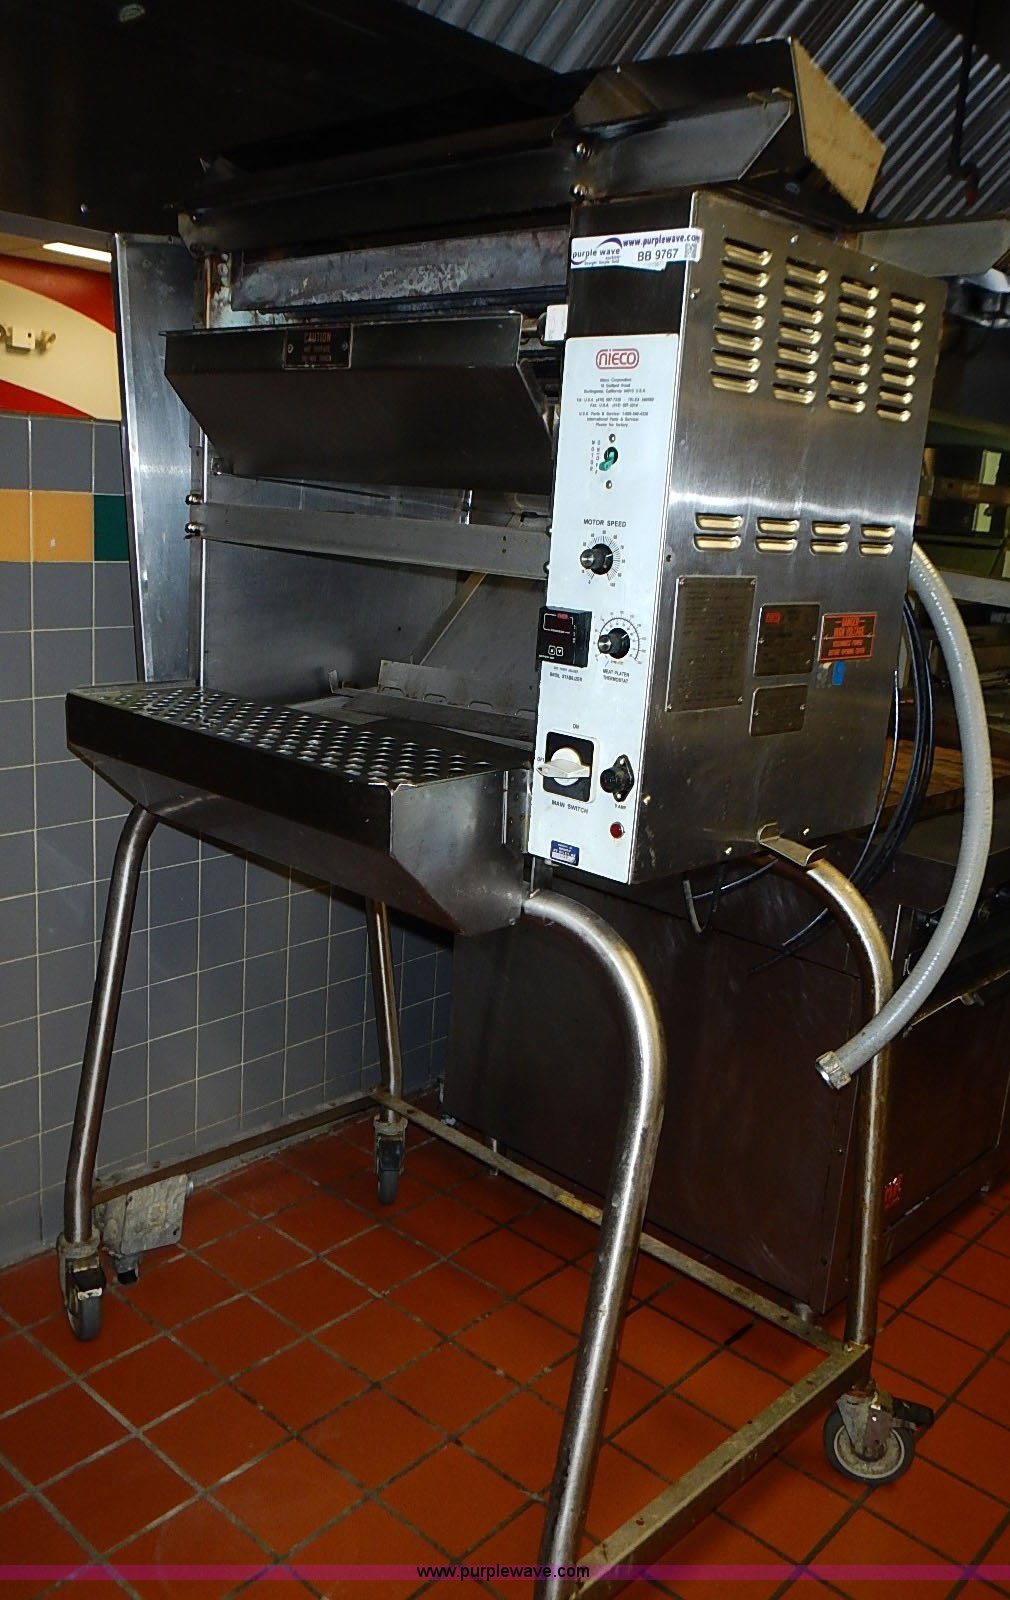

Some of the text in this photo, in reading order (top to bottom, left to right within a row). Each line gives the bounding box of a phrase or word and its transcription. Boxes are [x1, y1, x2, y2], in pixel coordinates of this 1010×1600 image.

[572, 249, 597, 259] purple
[637, 248, 679, 262] BB 9767
[607, 520, 627, 528] SPEED
[551, 799, 589, 815] MAIN SWITCH
